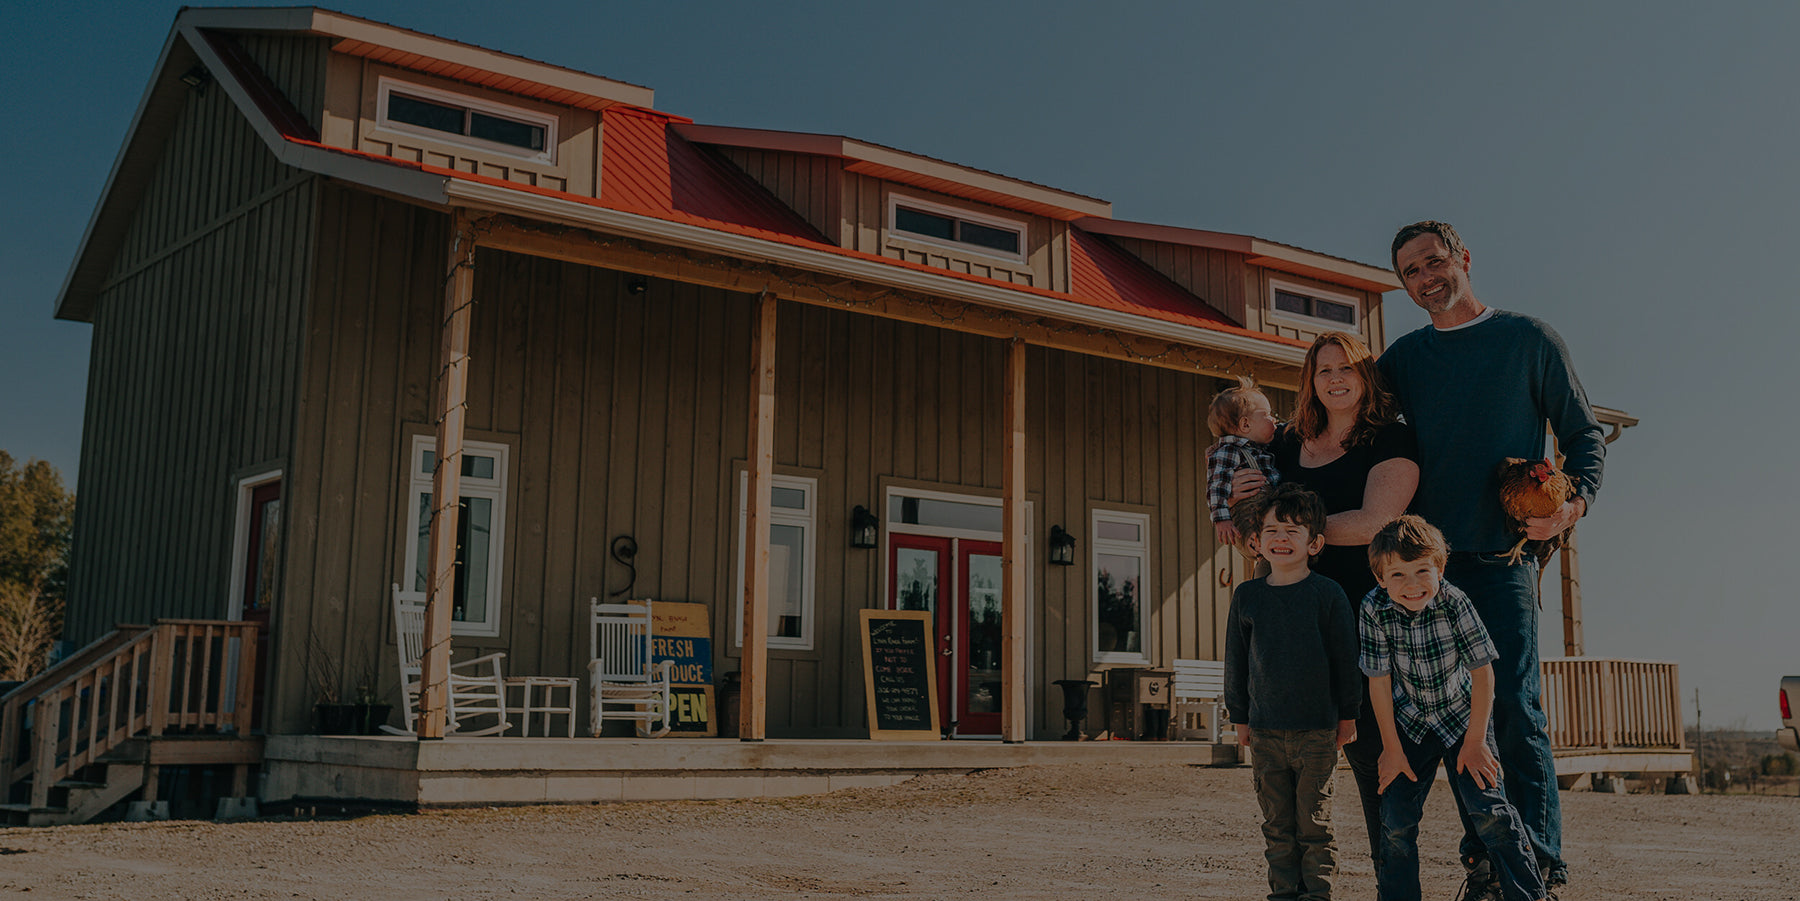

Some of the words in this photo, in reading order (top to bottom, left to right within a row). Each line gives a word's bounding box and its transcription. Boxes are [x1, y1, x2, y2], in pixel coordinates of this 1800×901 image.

[651, 638, 694, 658] FRESH
[642, 662, 705, 683] RDUCE
[650, 692, 708, 723] OPEN
